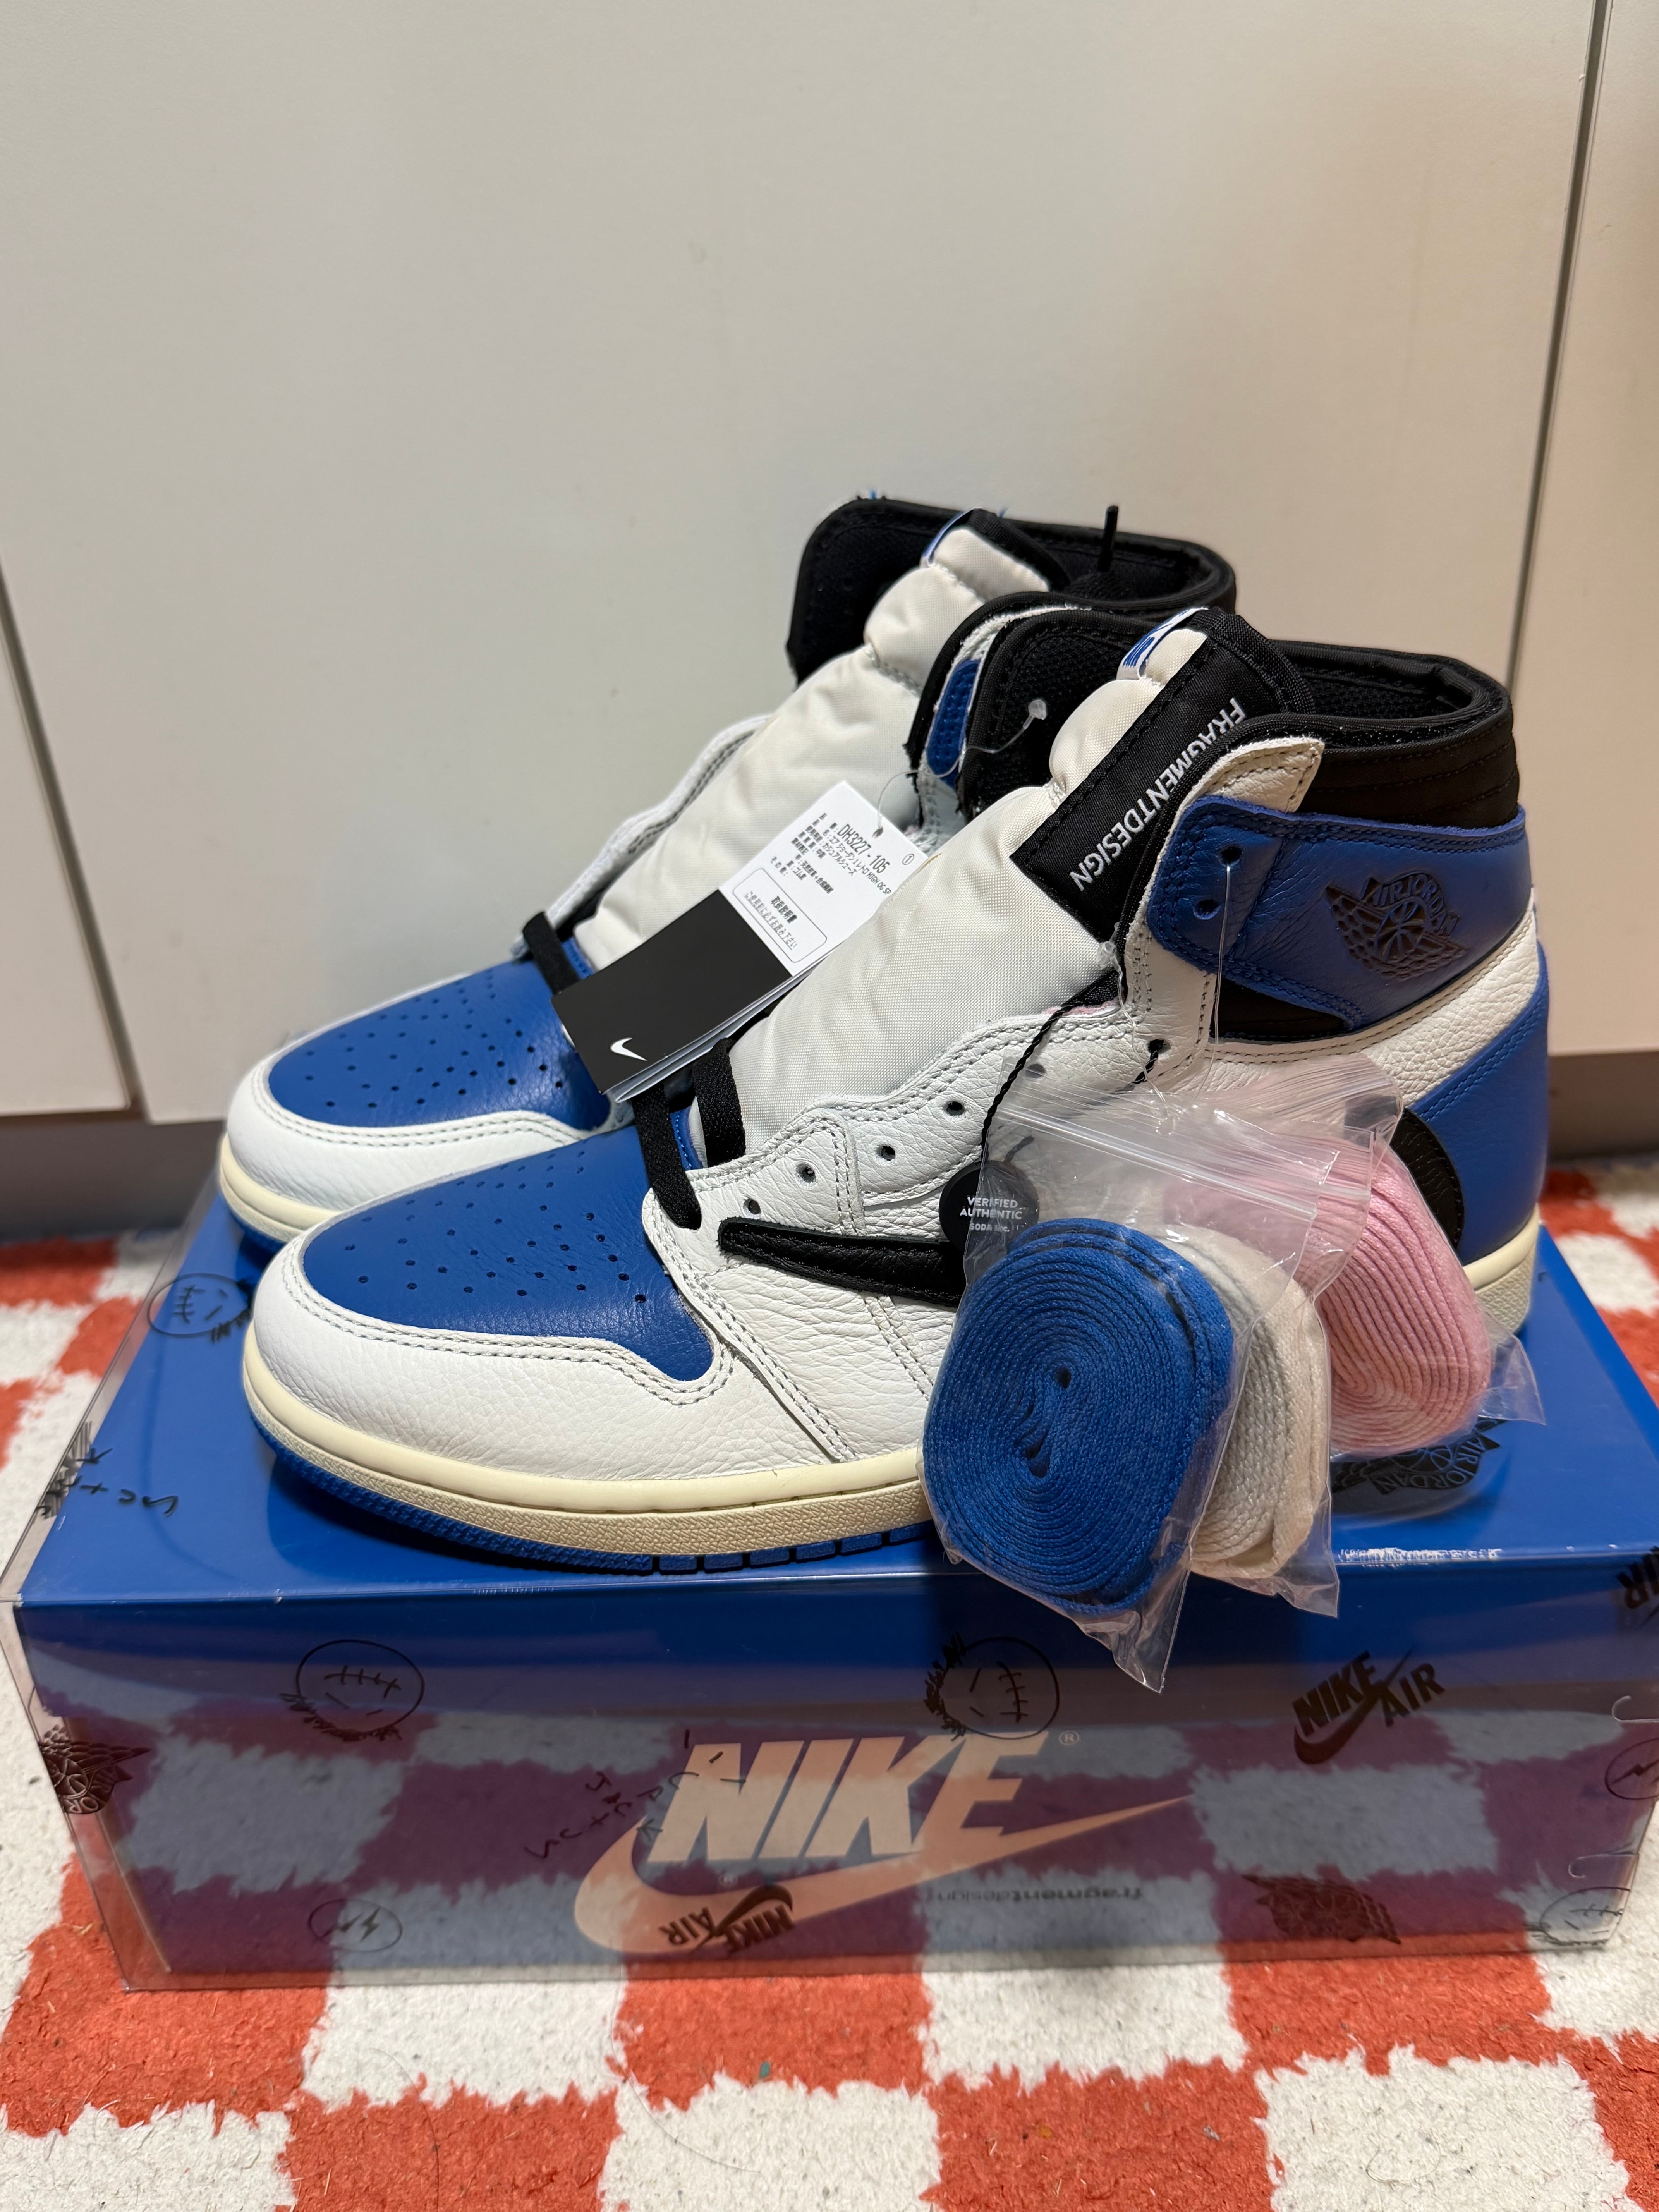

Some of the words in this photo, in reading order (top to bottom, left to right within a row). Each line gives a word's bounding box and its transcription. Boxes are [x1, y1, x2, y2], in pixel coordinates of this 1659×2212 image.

[1069, 698, 1246, 892] FRAGMENTDESIGN
[837, 824, 872, 855] DH3227
[869, 855, 890, 873] 105
[959, 1208, 1023, 1220] AUTHENTIC
[967, 1197, 1018, 1208] VERIFIED
[970, 1223, 993, 1231] SODA
[1291, 1649, 1378, 1736] NIKE
[1380, 1662, 1445, 1727] AIR
[648, 1731, 1050, 1862] NIKE
[658, 1906, 717, 1945] AIR
